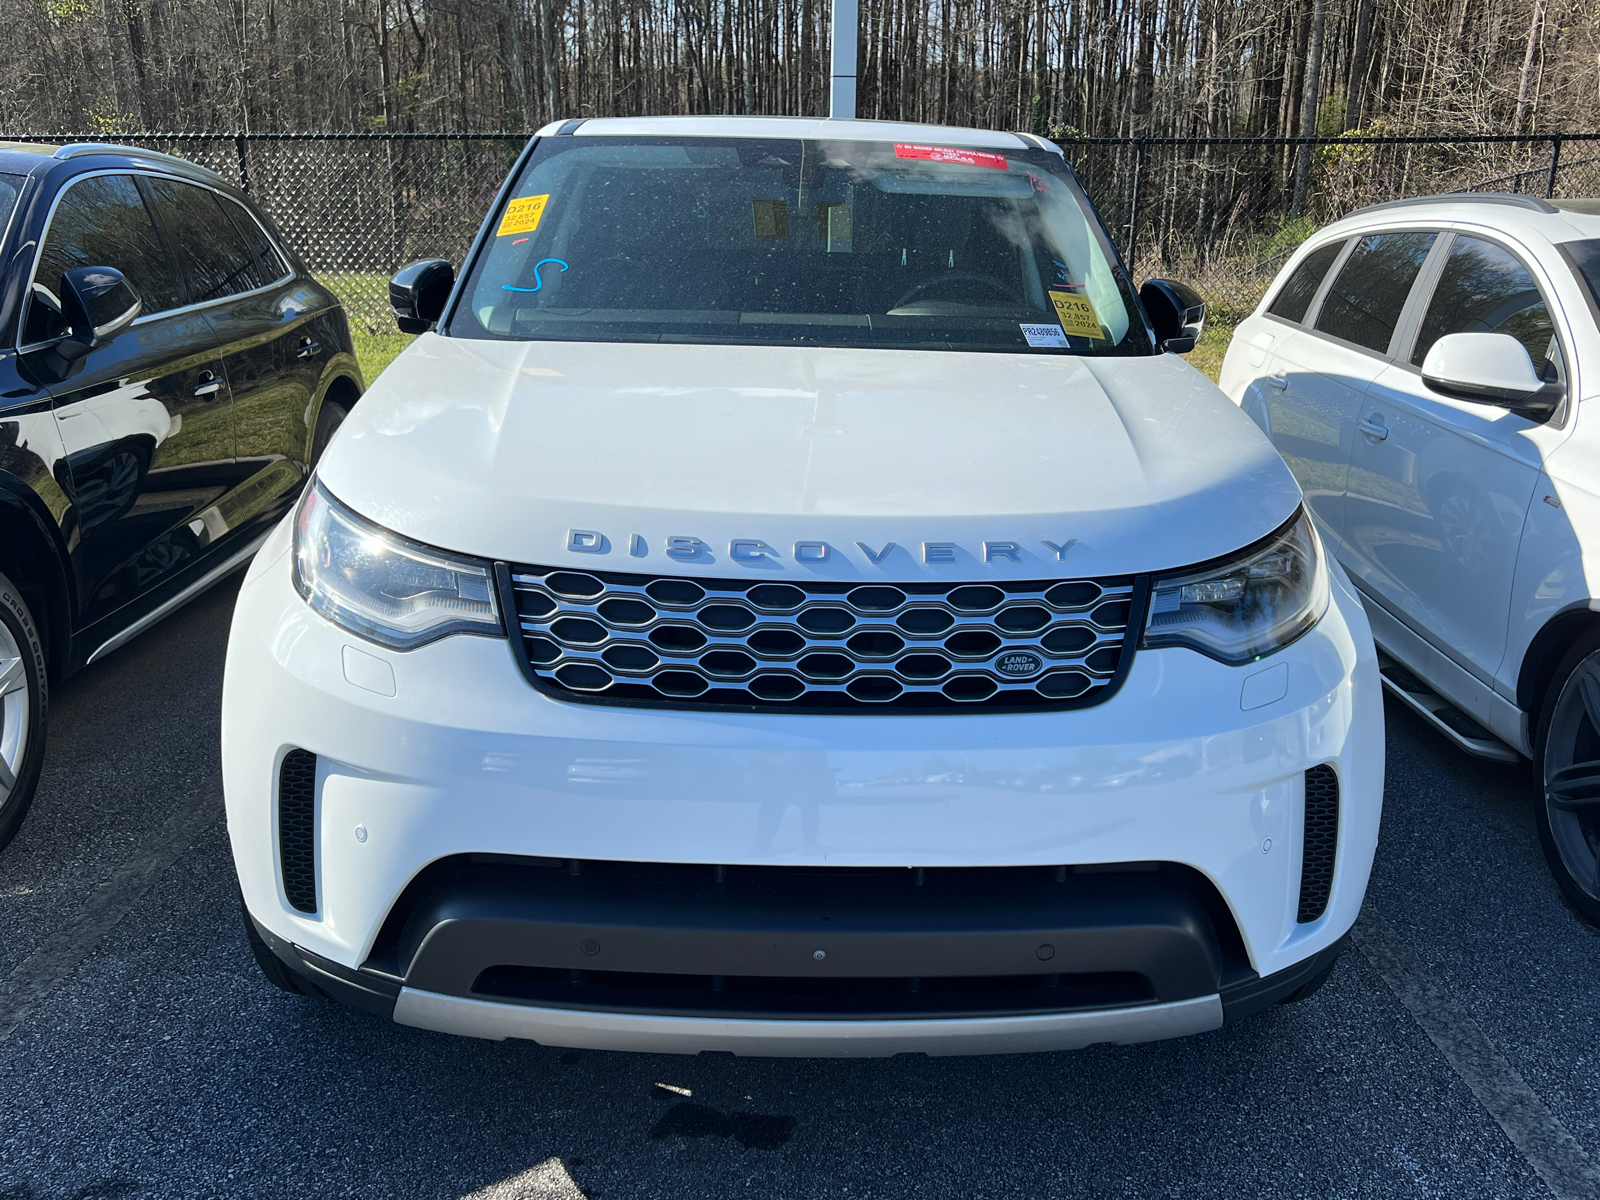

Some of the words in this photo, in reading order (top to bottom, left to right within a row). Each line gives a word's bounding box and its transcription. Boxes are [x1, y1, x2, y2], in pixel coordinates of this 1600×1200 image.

[507, 203, 541, 214] D216
[513, 218, 535, 226] 2024
[1054, 300, 1089, 313] D216
[1074, 320, 1097, 329] 2024
[565, 528, 1078, 564] DISCOVERY
[1004, 656, 1027, 664] LAND
[1007, 663, 1035, 671] ROVER
